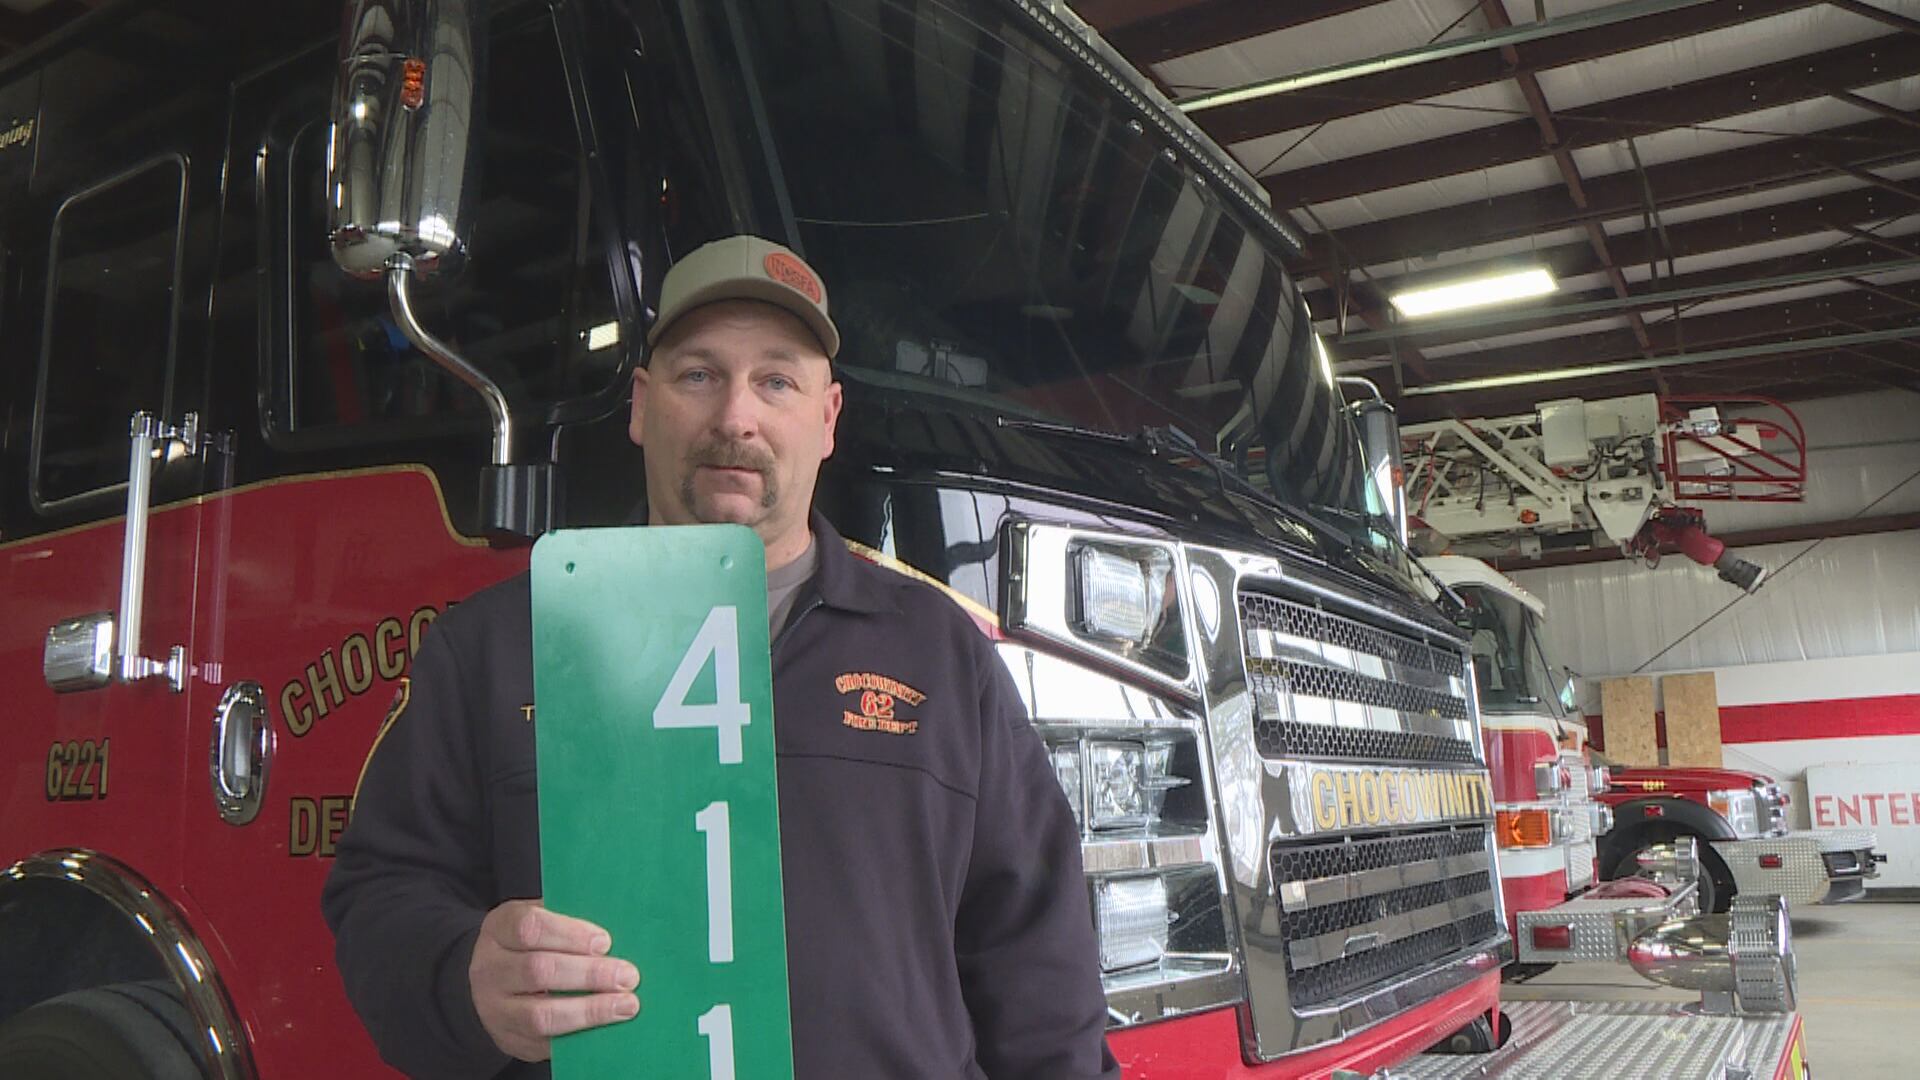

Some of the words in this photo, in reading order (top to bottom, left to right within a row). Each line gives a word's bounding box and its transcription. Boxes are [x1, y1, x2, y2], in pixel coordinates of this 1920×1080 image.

[279, 602, 458, 737] CHOCO
[843, 711, 876, 730] FIRE
[861, 691, 894, 719] 62
[46, 737, 110, 801] 6221
[1312, 769, 1492, 829] CHOCOWINITY
[289, 795, 355, 858] DE
